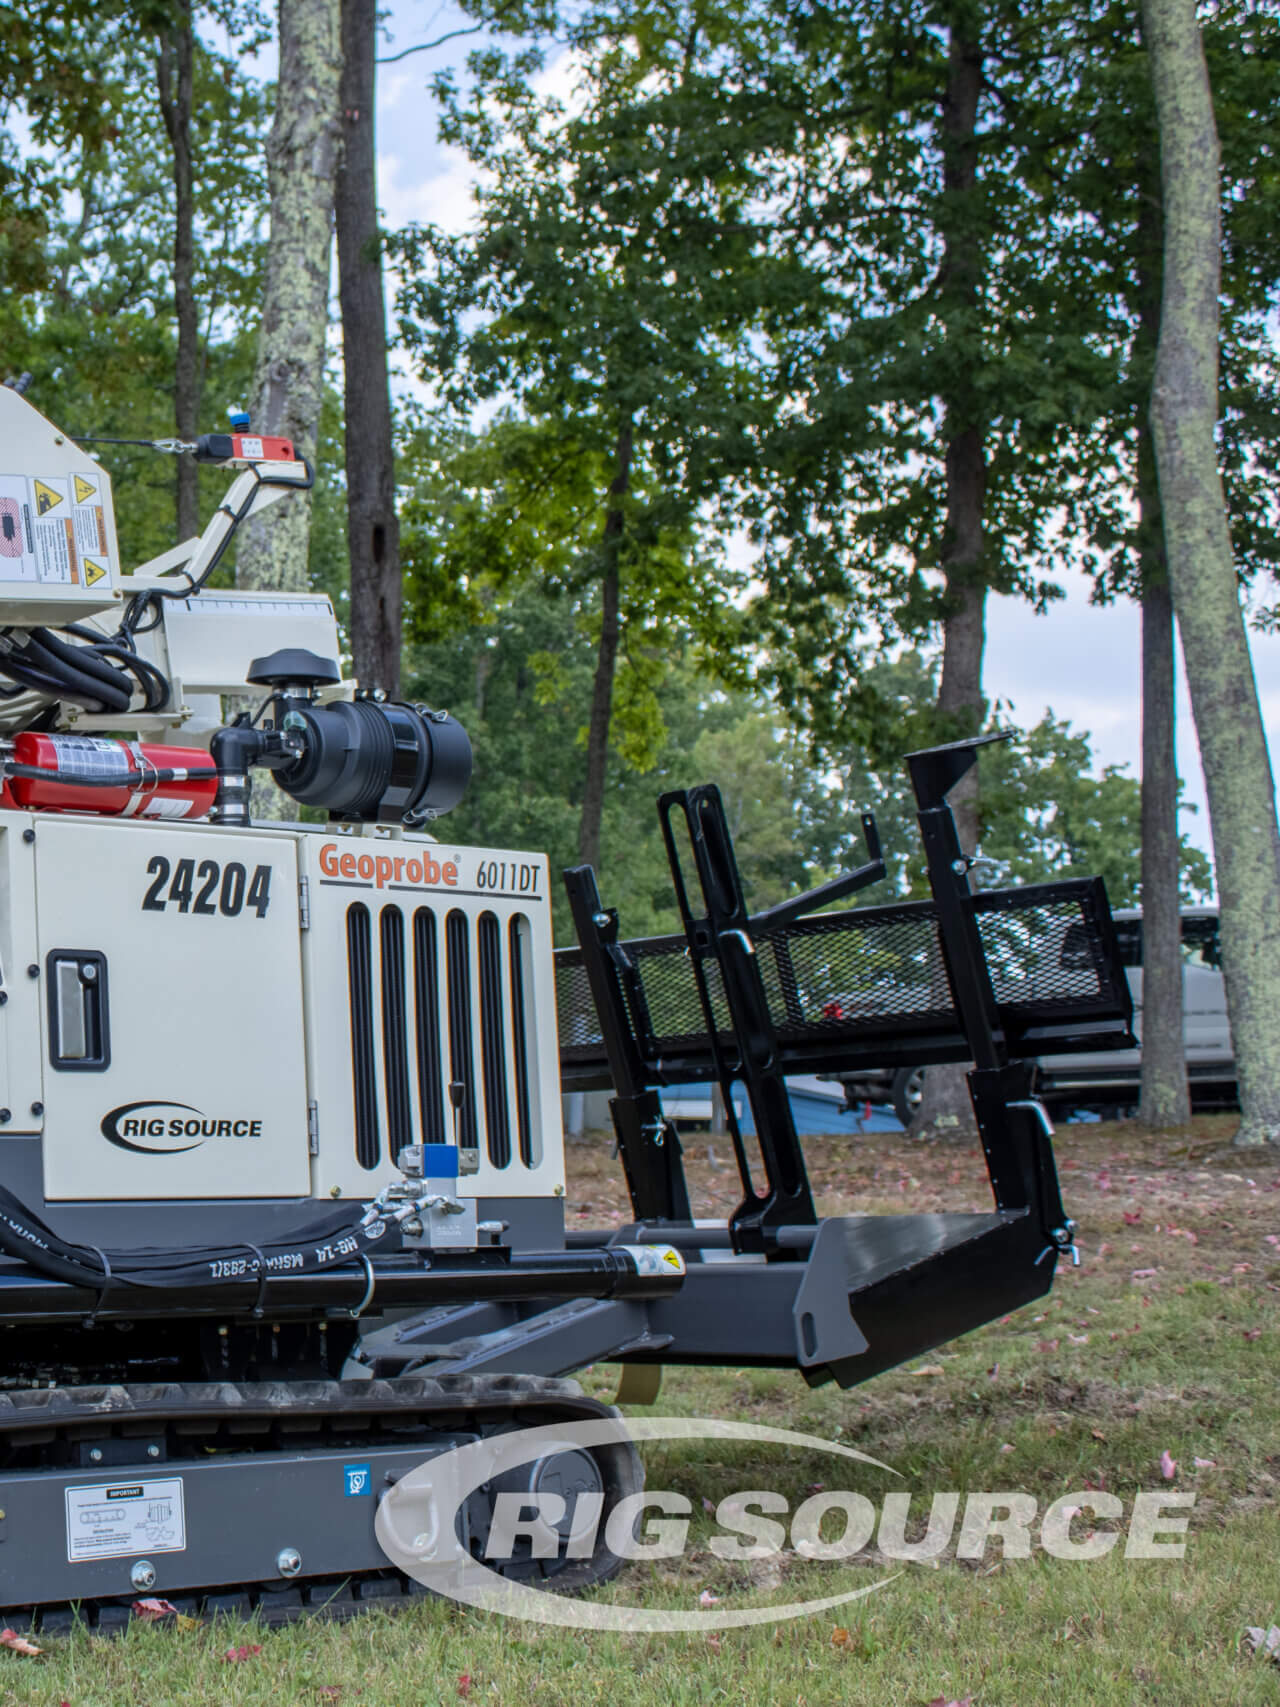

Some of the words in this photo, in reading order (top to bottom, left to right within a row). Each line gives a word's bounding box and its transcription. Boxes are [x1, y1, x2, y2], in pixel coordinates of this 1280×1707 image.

[142, 856, 272, 919] 24204
[476, 861, 541, 892] 6011DT
[123, 1119, 165, 1137] RIG
[168, 1119, 263, 1137] SOURCE
[317, 1237, 359, 1263] HG-14
[209, 1261, 261, 1278] C-293/1
[110, 1488, 140, 1497] IMPORTANT
